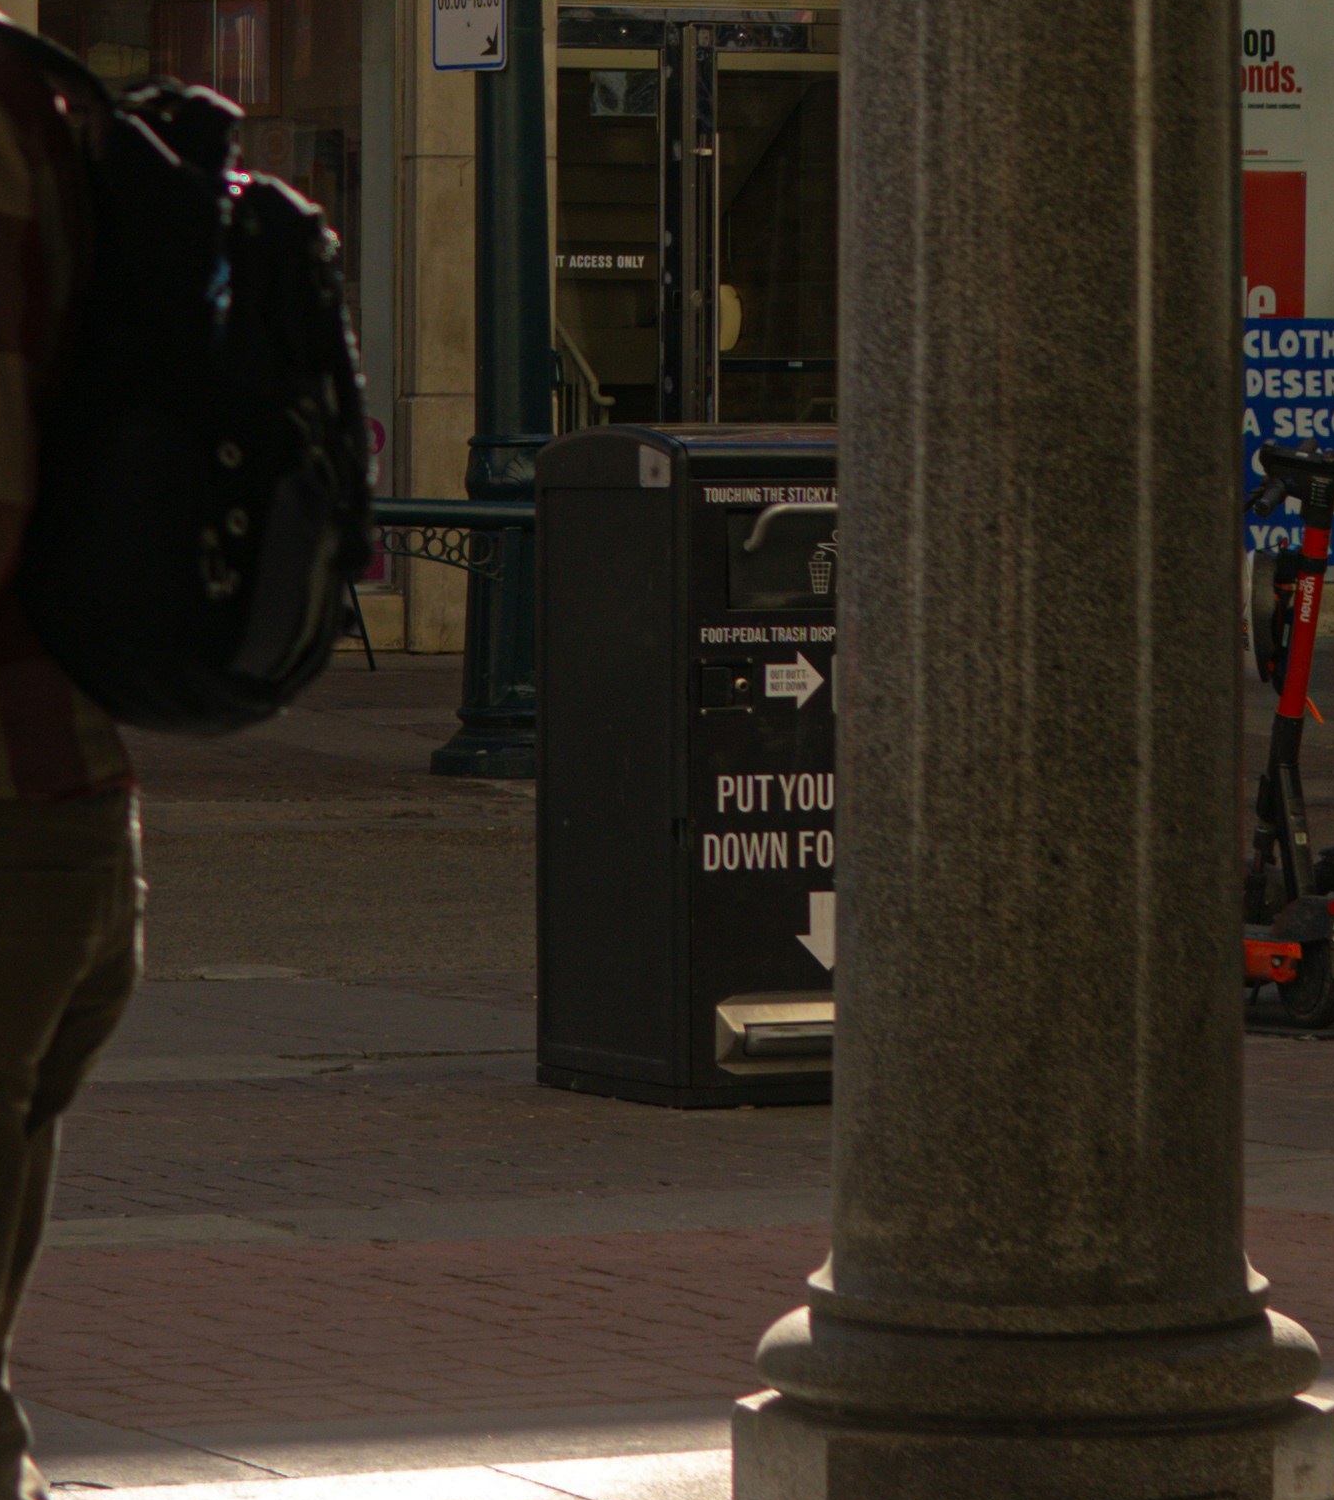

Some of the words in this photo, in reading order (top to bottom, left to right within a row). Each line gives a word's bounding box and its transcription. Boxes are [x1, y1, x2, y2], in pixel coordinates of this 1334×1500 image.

[569, 254, 613, 269] ACCESS
[617, 254, 645, 269] ONLY
[1242, 407, 1261, 437] A
[703, 487, 762, 503] TOUCHING
[762, 487, 787, 502] THE
[787, 486, 829, 502] STICKY
[1299, 575, 1316, 623] neuron
[700, 627, 770, 643] FOOT-PEDAL
[770, 627, 807, 642] TRASH
[810, 626, 836, 642] DISP
[717, 774, 774, 813] PUT
[778, 772, 834, 812] YOU
[703, 831, 788, 871] DOWN
[798, 829, 834, 869] FO
